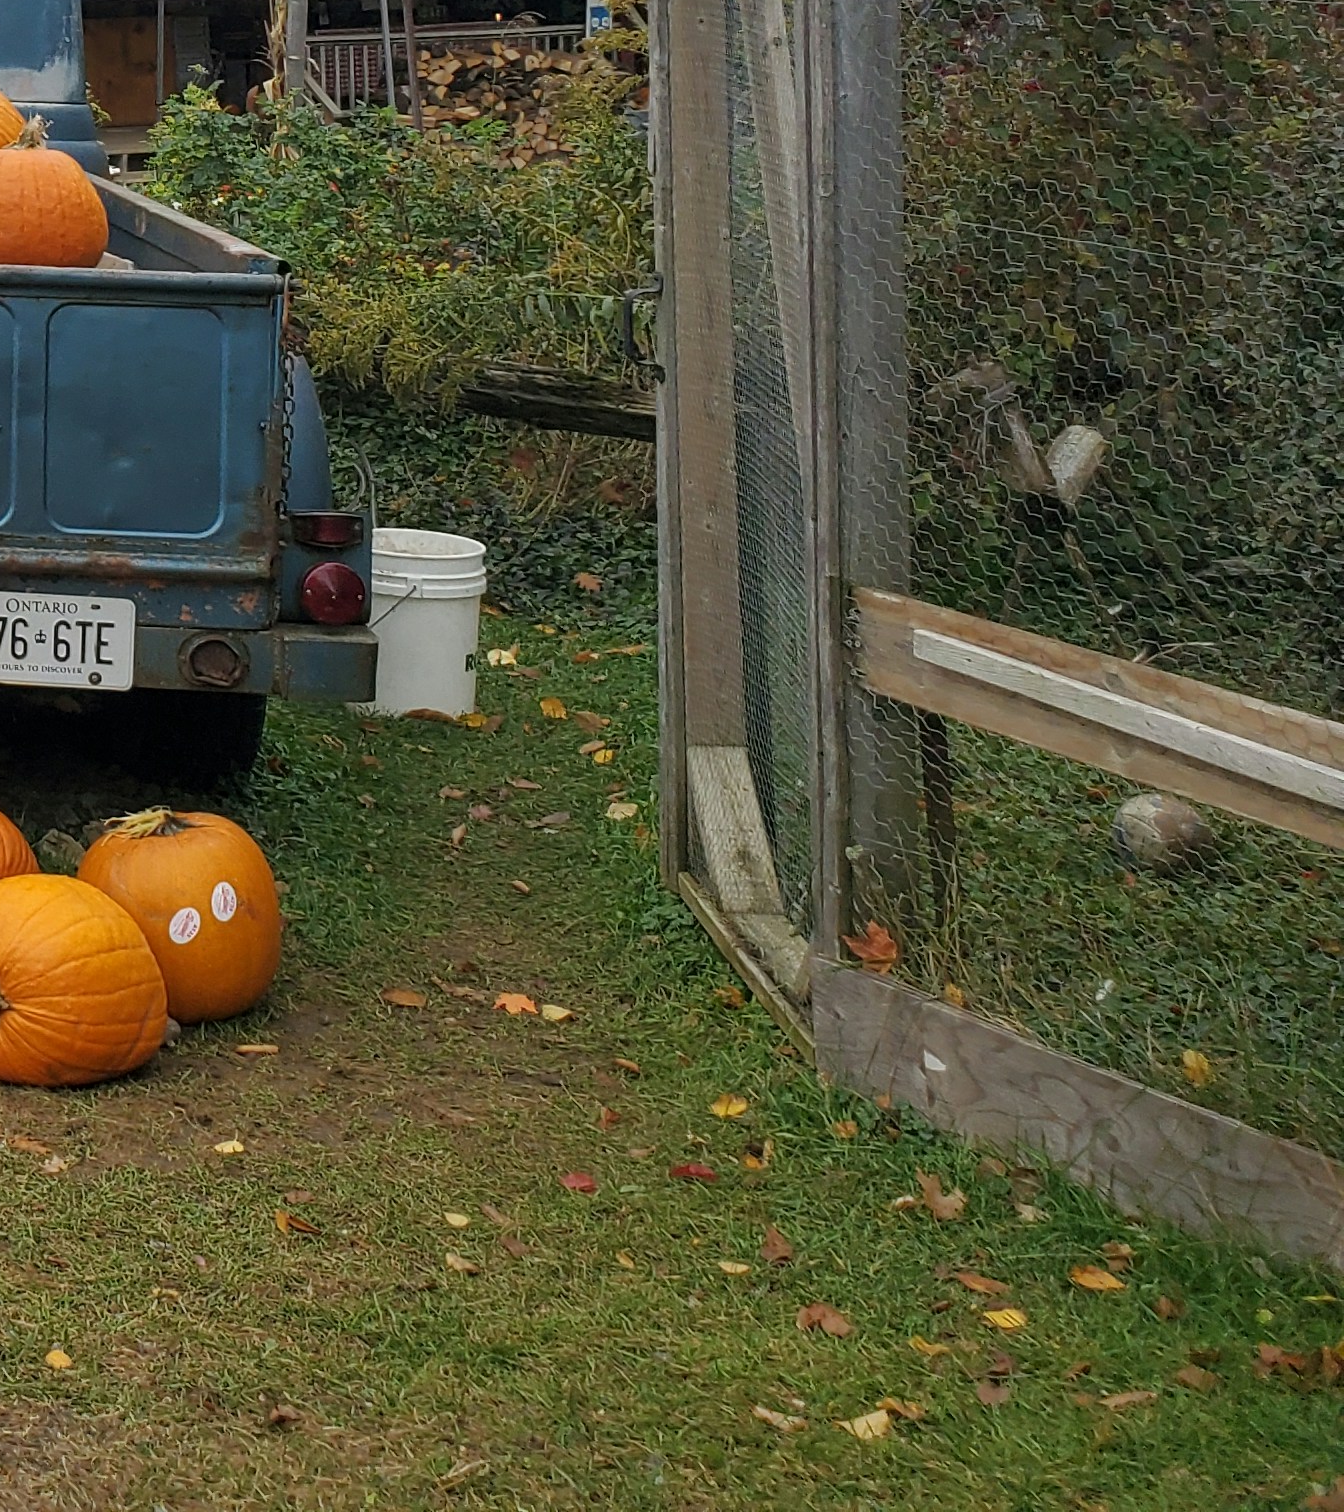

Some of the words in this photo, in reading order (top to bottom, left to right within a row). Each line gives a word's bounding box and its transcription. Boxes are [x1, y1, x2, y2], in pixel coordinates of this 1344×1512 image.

[6, 598, 79, 615] ONTARIO
[52, 619, 115, 665] 6TE
[41, 665, 83, 674] DISCOVER
